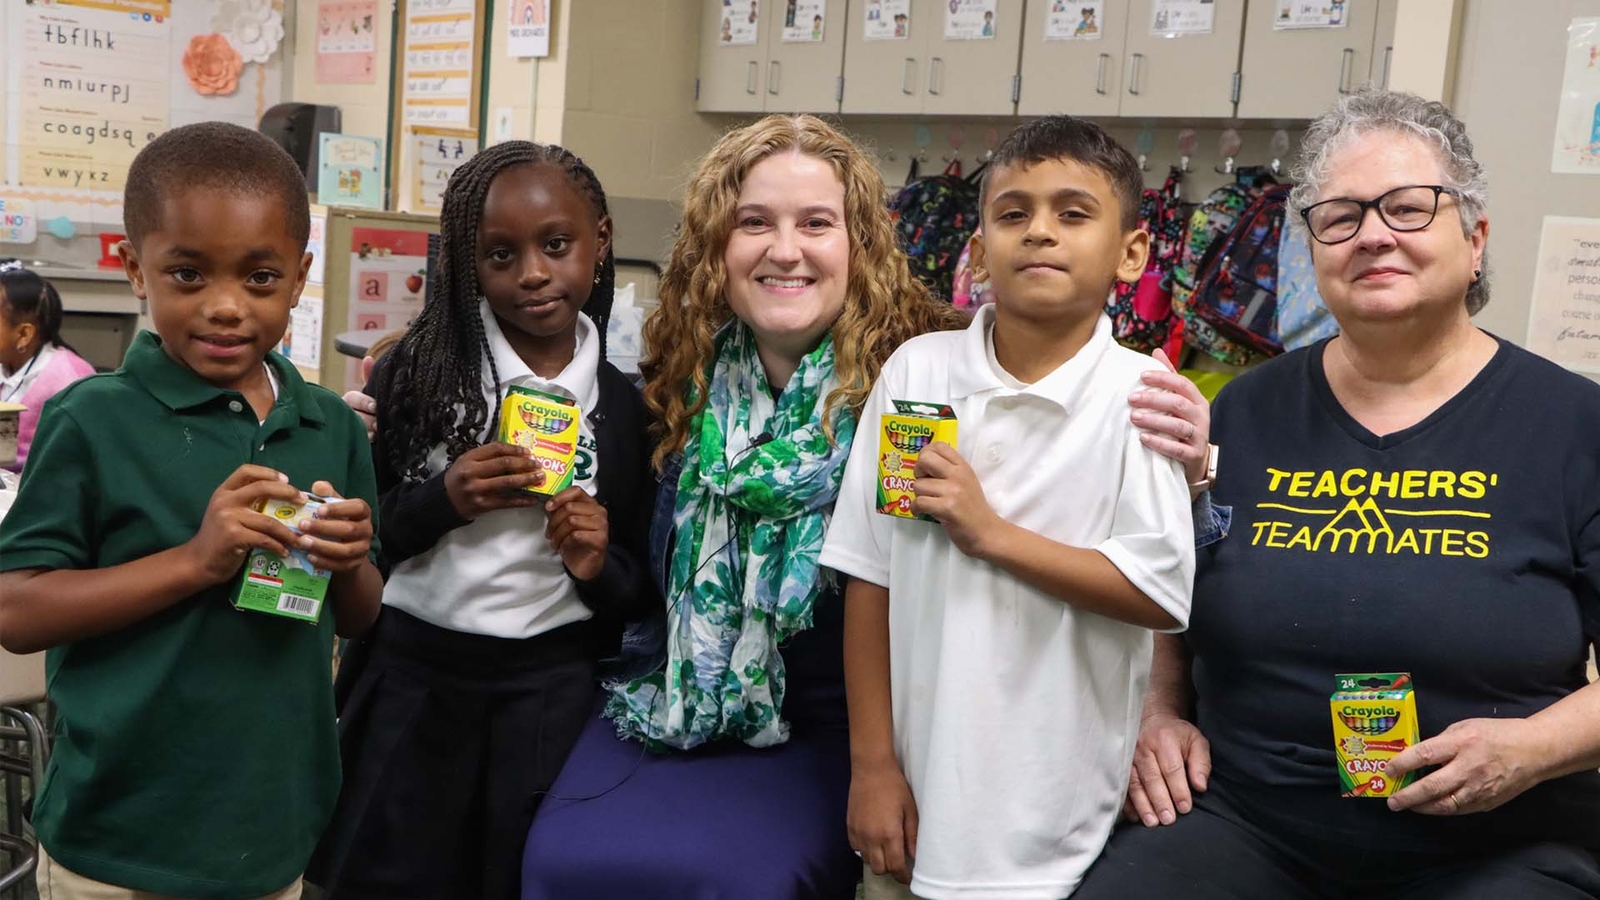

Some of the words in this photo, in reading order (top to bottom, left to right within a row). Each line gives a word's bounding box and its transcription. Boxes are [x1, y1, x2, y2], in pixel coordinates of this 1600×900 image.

[365, 279, 380, 296] a
[522, 401, 570, 420] Crayola
[889, 420, 931, 436] Crayola
[1266, 467, 1498, 499] TEACHERS'
[899, 498, 910, 509] 24
[1341, 679, 1356, 689] 24
[1342, 705, 1395, 718] Crayola
[1370, 778, 1385, 790] 24
